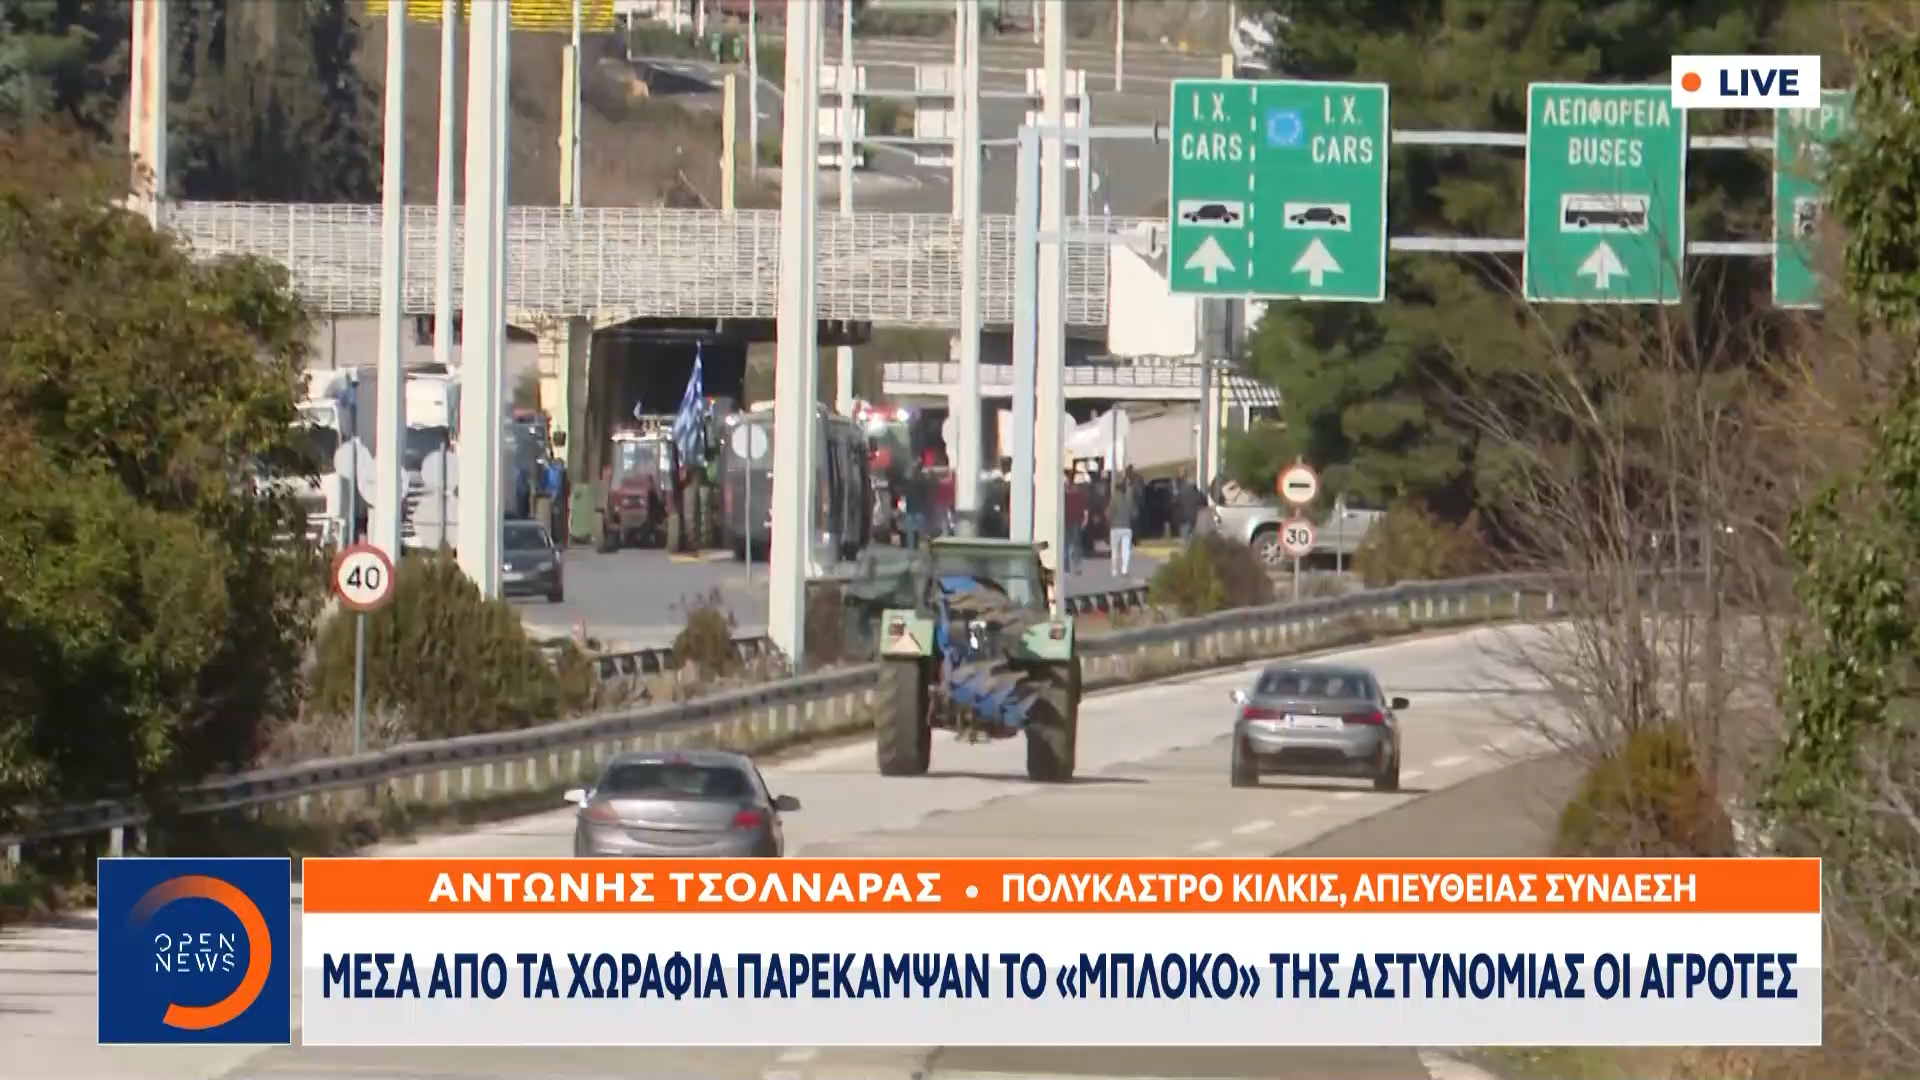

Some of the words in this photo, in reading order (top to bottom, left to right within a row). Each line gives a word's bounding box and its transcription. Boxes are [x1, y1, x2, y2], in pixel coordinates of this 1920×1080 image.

[1181, 133, 1243, 161] CARS
[1311, 136, 1374, 164] CARS
[1567, 136, 1644, 167] BUSES
[1286, 528, 1309, 546] 30
[346, 565, 380, 590] 40
